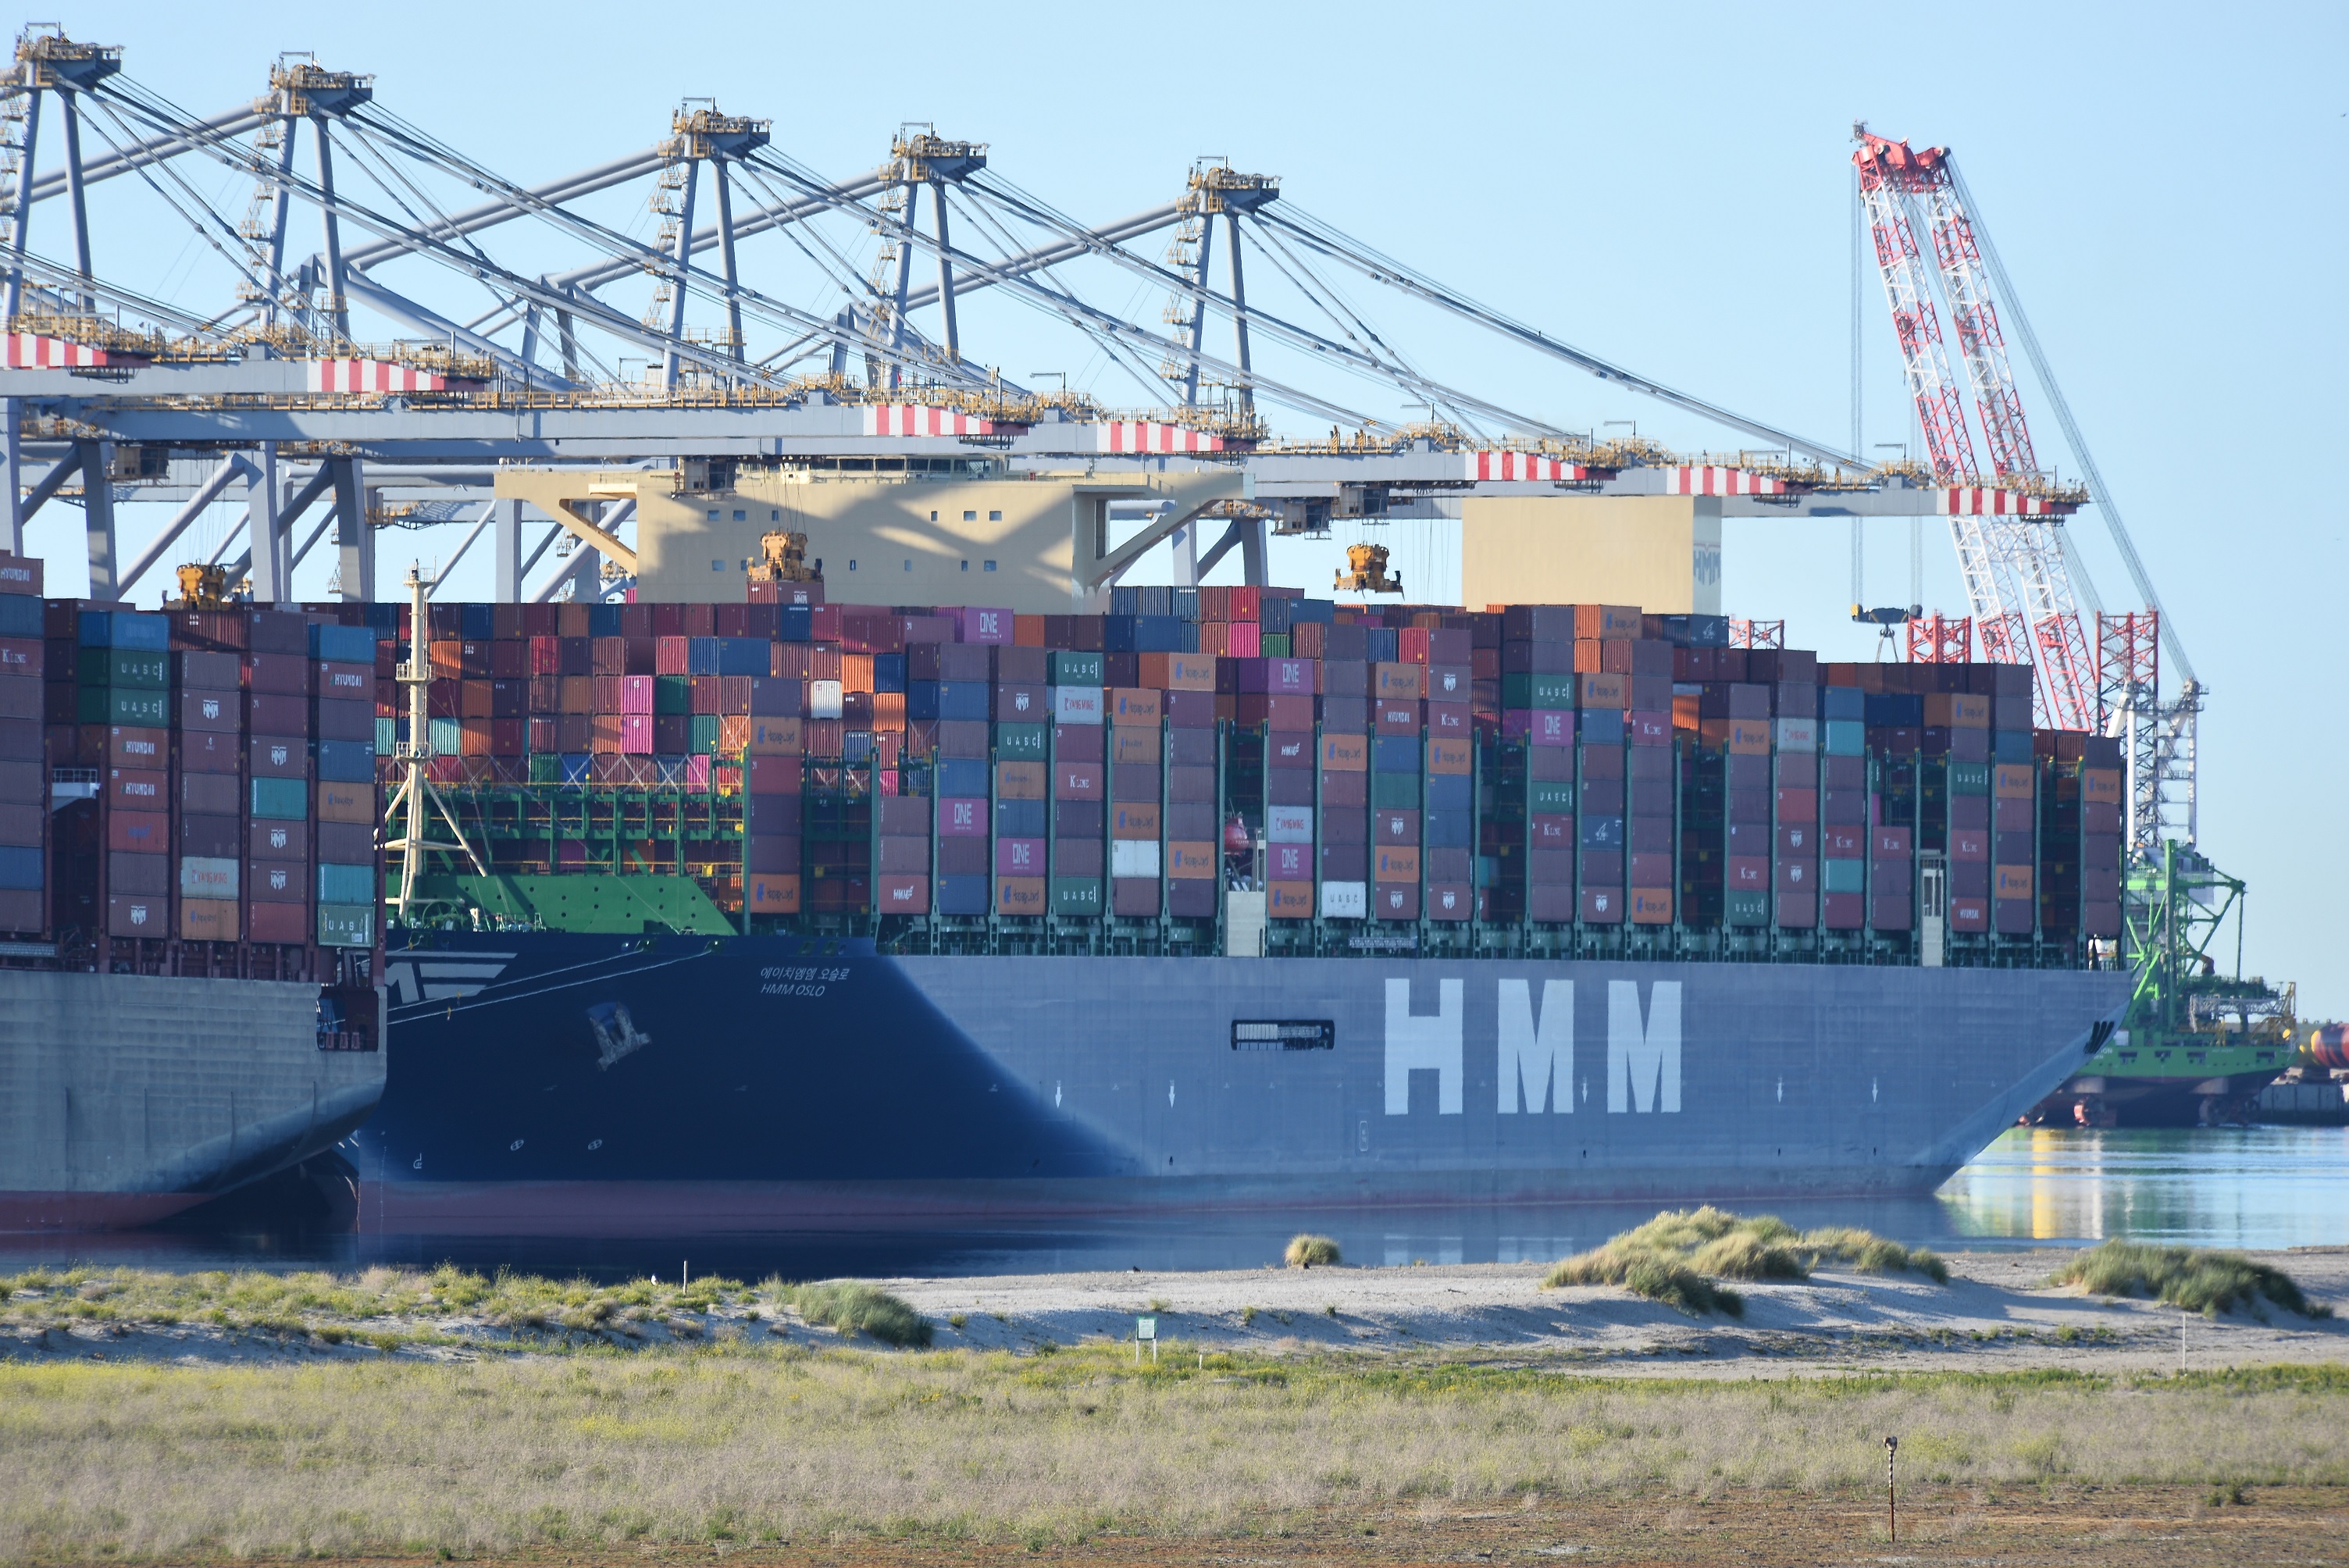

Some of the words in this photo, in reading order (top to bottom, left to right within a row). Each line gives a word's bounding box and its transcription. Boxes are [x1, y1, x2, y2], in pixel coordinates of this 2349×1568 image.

[980, 612, 997, 633] ONE
[121, 663, 158, 675] UASC
[1064, 664, 1094, 674] UASC
[1282, 664, 1299, 683] ONE
[335, 674, 362, 687] HYUNDAI
[1539, 687, 1566, 697] UASC
[121, 700, 158, 713] UASC
[1545, 715, 1560, 735] ONE
[126, 741, 155, 754] HYUNDAI
[1007, 736, 1036, 746] UASC
[126, 783, 155, 796] HYUNDAI
[1539, 792, 1567, 801] UASC
[954, 803, 971, 824] ONE
[1012, 843, 1030, 864] ONE
[1281, 849, 1298, 868] ONE
[1064, 891, 1093, 900] UASC
[1330, 894, 1358, 903] UASC
[818, 968, 850, 981] 오슬로
[761, 984, 794, 994] HMM
[796, 985, 825, 996] OSLO
[1385, 978, 1681, 1114] HMM
